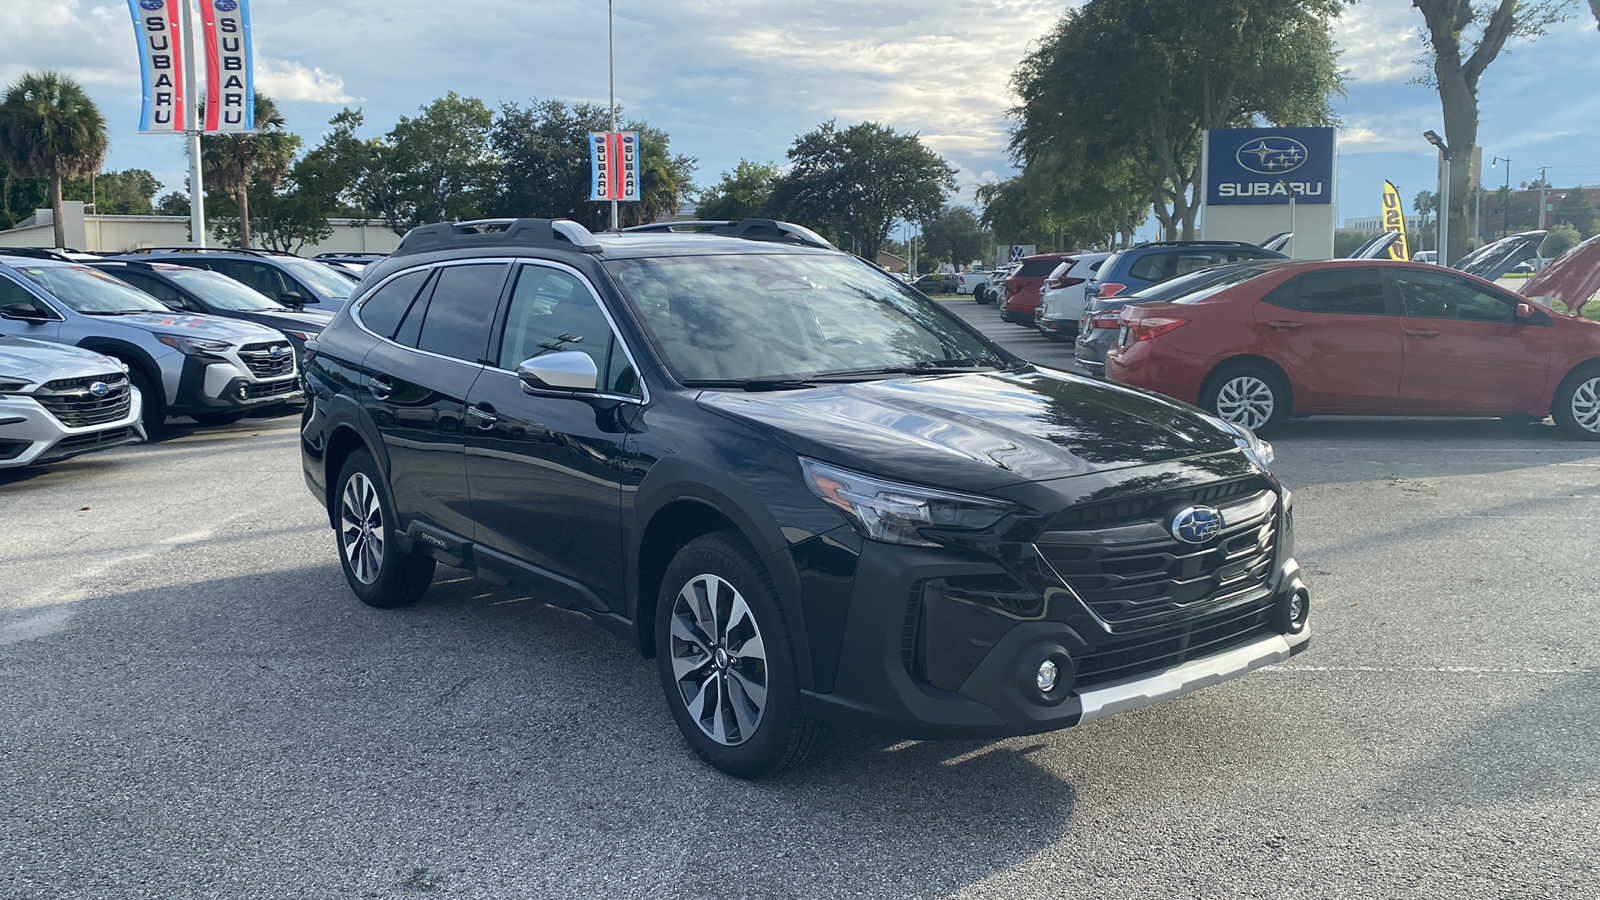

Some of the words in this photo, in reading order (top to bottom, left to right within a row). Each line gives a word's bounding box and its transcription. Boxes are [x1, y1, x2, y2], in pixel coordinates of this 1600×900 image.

[146, 16, 173, 124] SUBARU
[220, 17, 243, 124] SUBARU
[597, 145, 606, 196] SUBARU
[625, 145, 634, 196] SUBARU
[1218, 182, 1322, 197] SUBARU
[421, 532, 447, 548] OUTBACK
